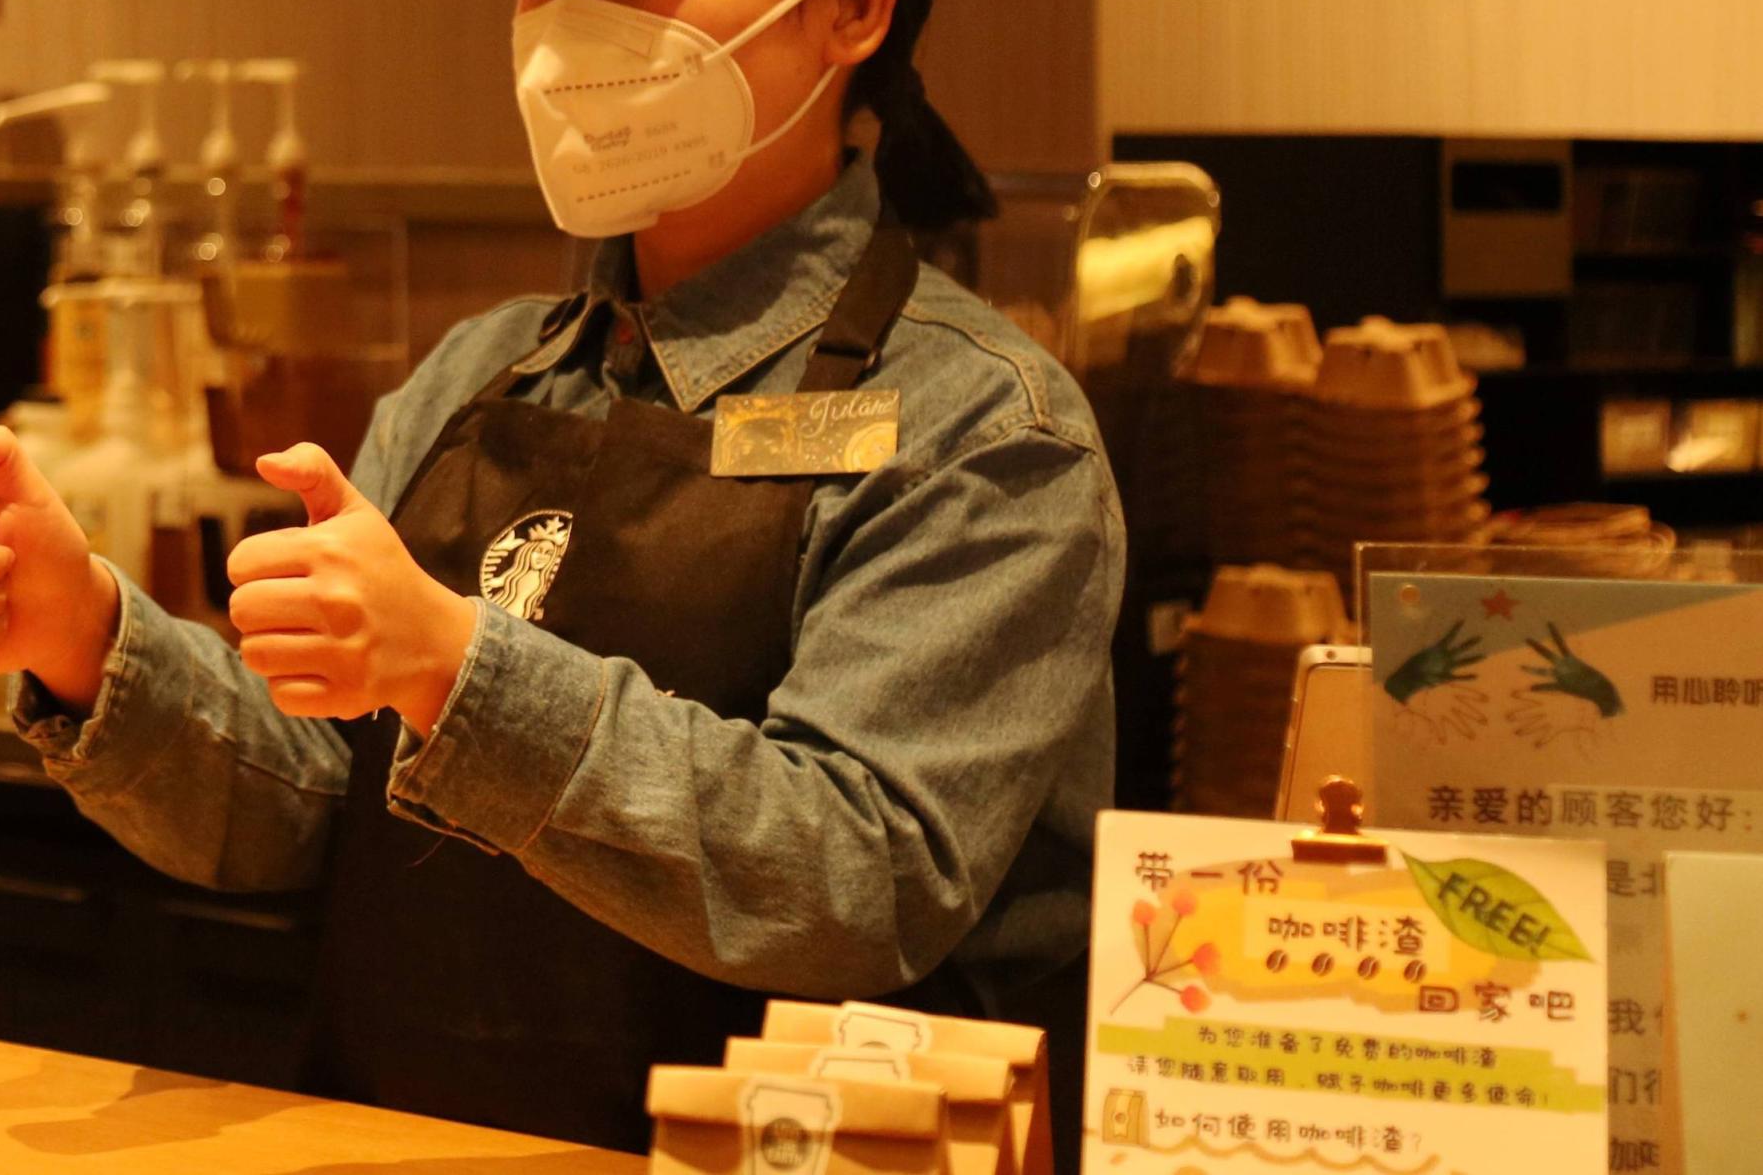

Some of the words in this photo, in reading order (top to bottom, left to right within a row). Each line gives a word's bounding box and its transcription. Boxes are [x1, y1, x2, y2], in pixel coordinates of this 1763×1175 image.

[1134, 851, 1284, 896] 带一份
[1267, 912, 1427, 958] 咖啡渣
[1437, 870, 1552, 963] FREE!
[1418, 983, 1577, 1024] 回家吧
[1198, 1025, 1497, 1069] 为您准备了免费的咖啡渣
